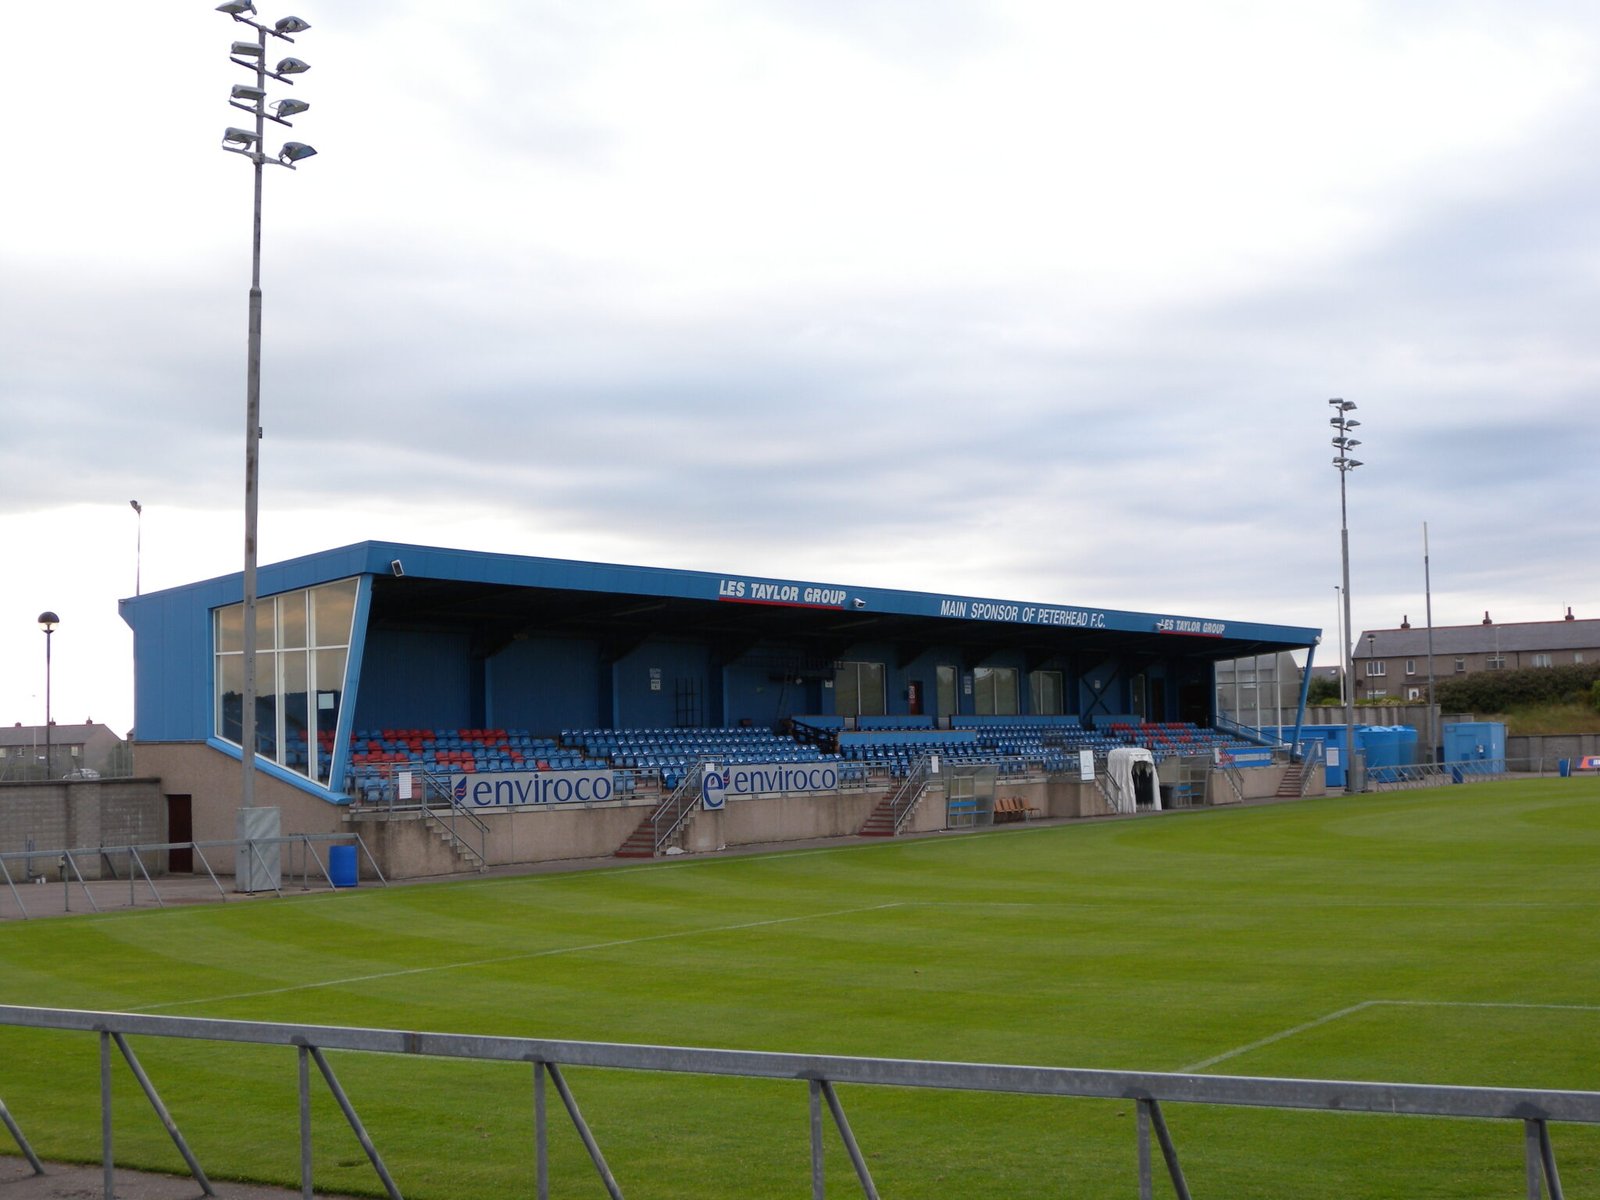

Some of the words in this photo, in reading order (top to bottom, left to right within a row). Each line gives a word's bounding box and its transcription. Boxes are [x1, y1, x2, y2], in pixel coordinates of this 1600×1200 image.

[719, 579, 745, 597] LES
[751, 583, 799, 602] TAYLOR
[804, 587, 847, 605] GROUP
[940, 599, 967, 618] MAIN
[970, 601, 1019, 622] SPONSOR
[1022, 606, 1037, 623] OF
[1037, 607, 1088, 628] PETERHEAD
[1090, 612, 1106, 628] F.C.
[1176, 620, 1201, 632] TAYLOR
[1202, 622, 1226, 634] GROUP
[472, 772, 612, 806] enviroco
[734, 765, 837, 793] enviroco
